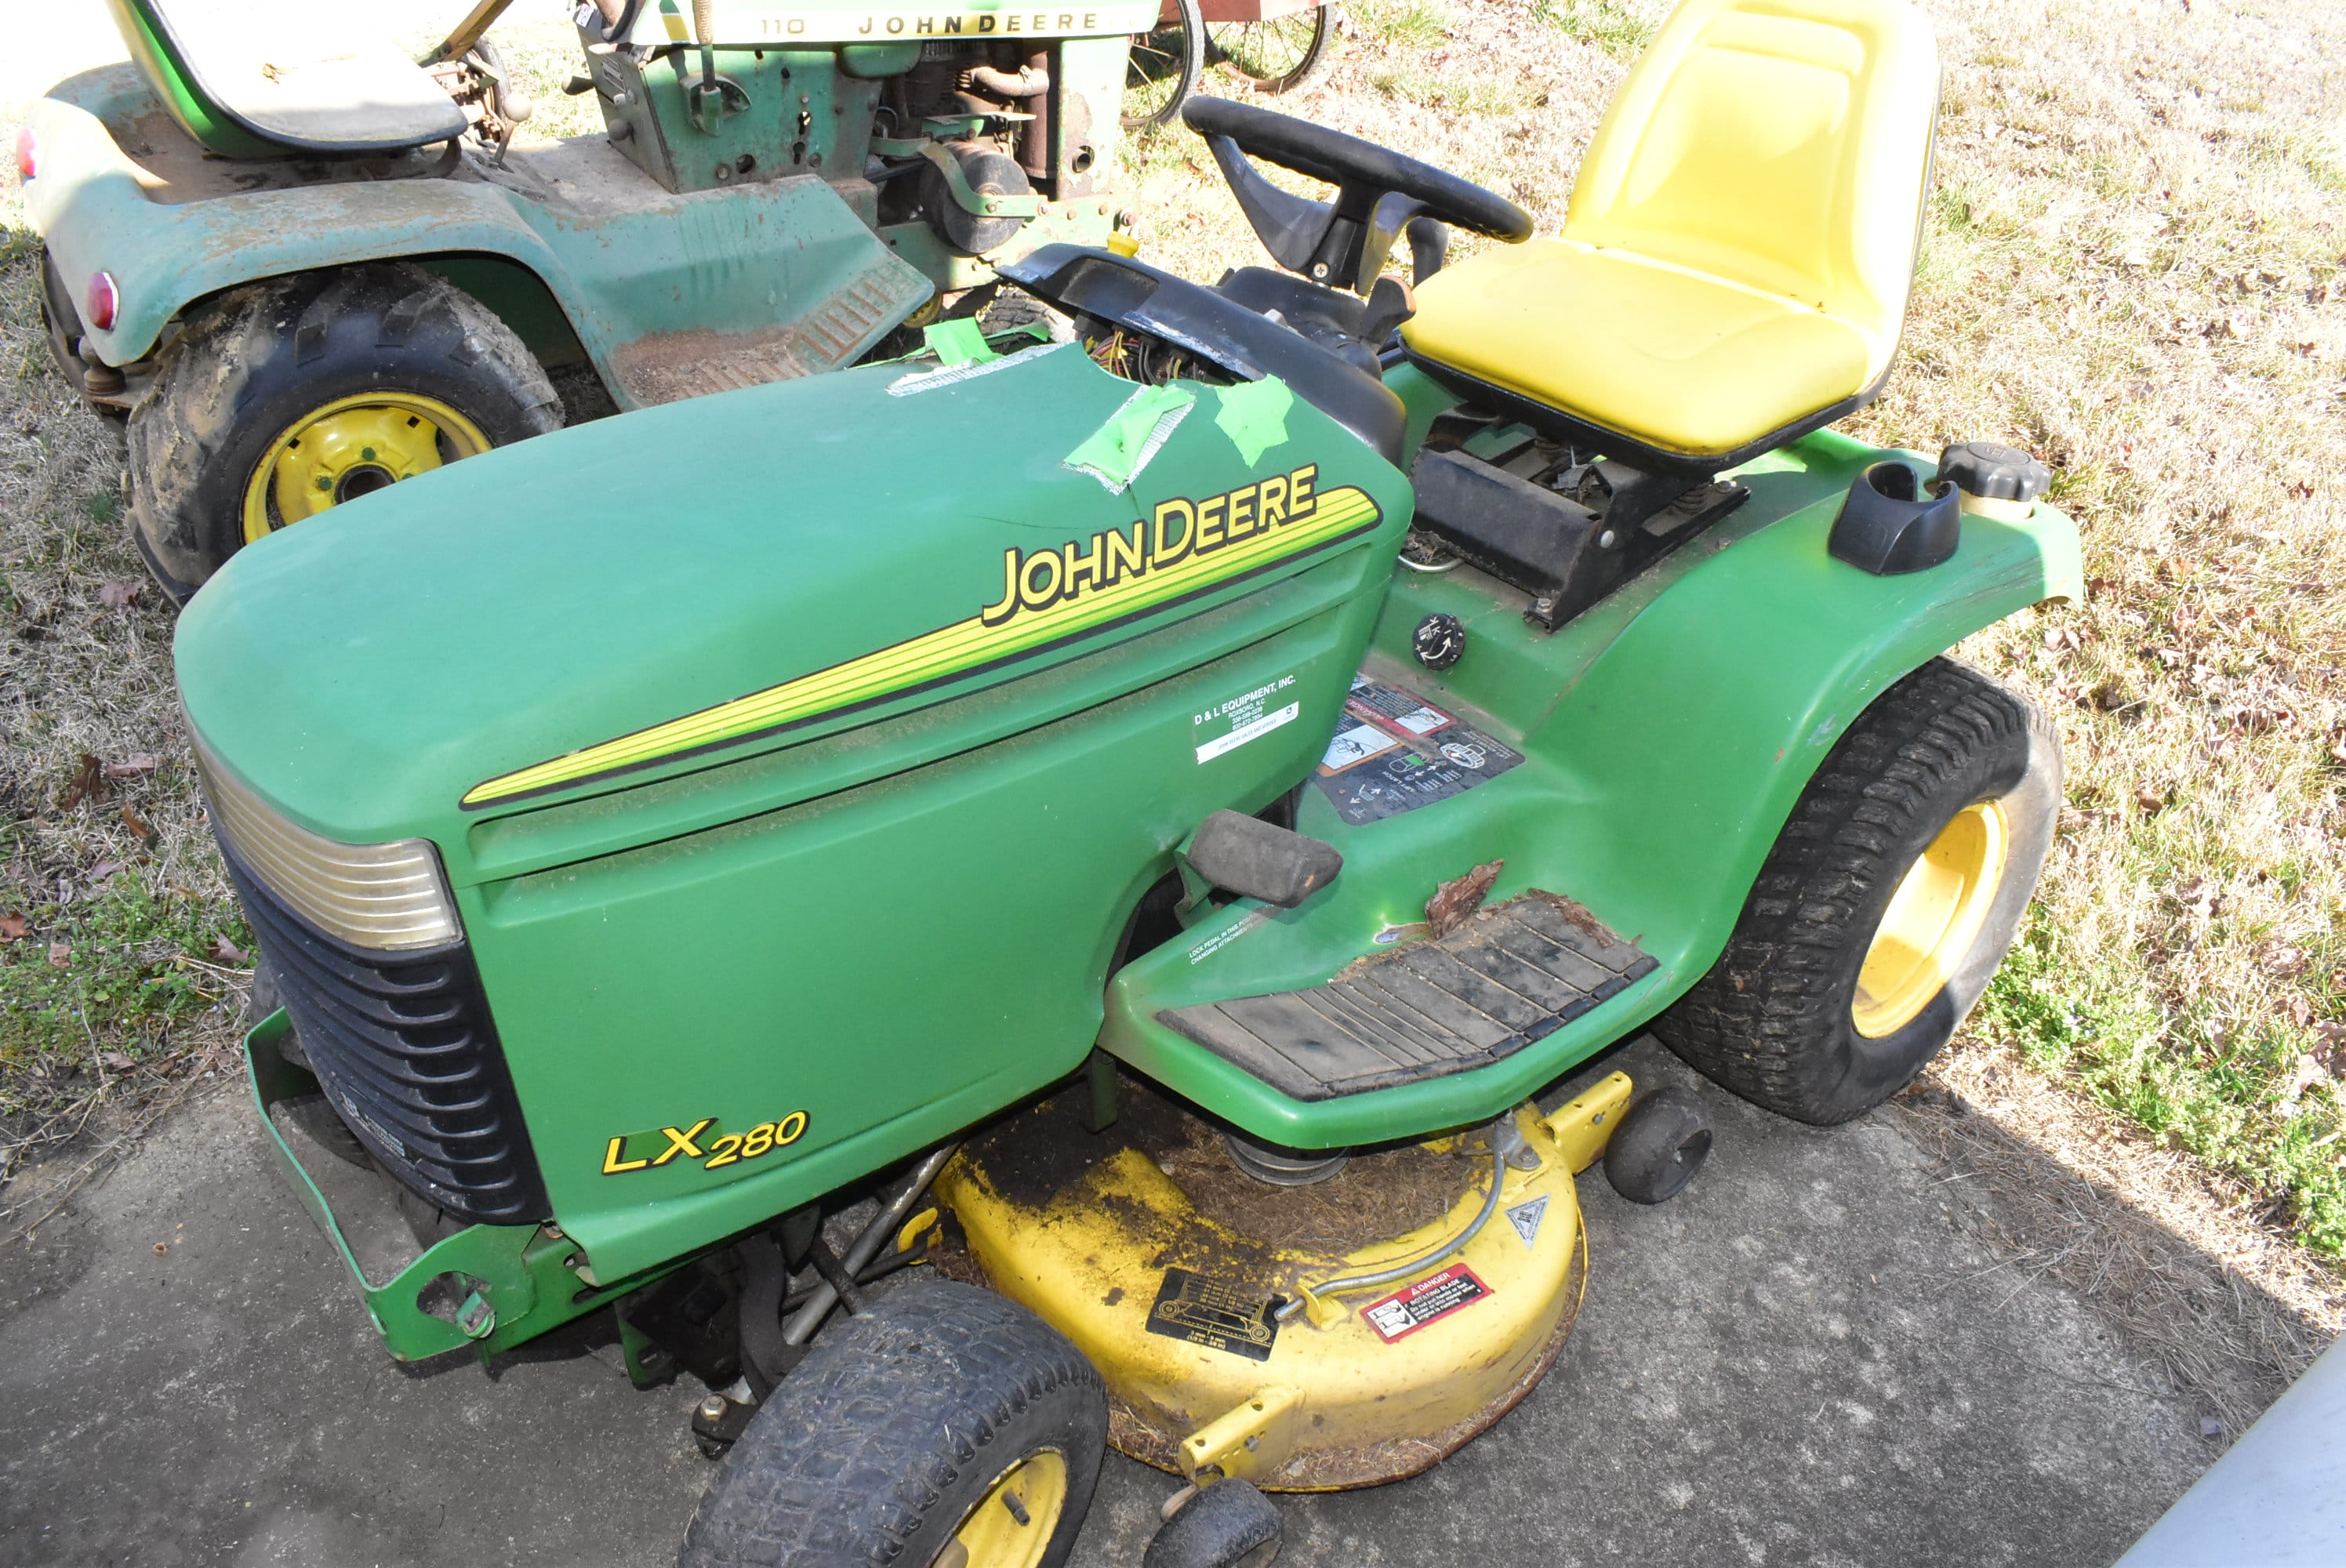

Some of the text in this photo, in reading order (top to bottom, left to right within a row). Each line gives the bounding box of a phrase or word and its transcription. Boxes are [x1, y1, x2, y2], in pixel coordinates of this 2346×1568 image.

[761, 13, 1097, 34] 110 JOHN DEERE
[981, 463, 1319, 626] JOHN DEERE
[1194, 675, 1296, 725] D & L EQUIPMENT, INC.
[1189, 945, 1204, 958] LOCK
[1204, 935, 1221, 949] PEDAL
[1226, 924, 1239, 934] THIS
[1190, 944, 1218, 965] CHANGING
[1409, 1278, 1461, 1306] ROTATING BLADE
[1417, 1272, 1451, 1291] DANGER
